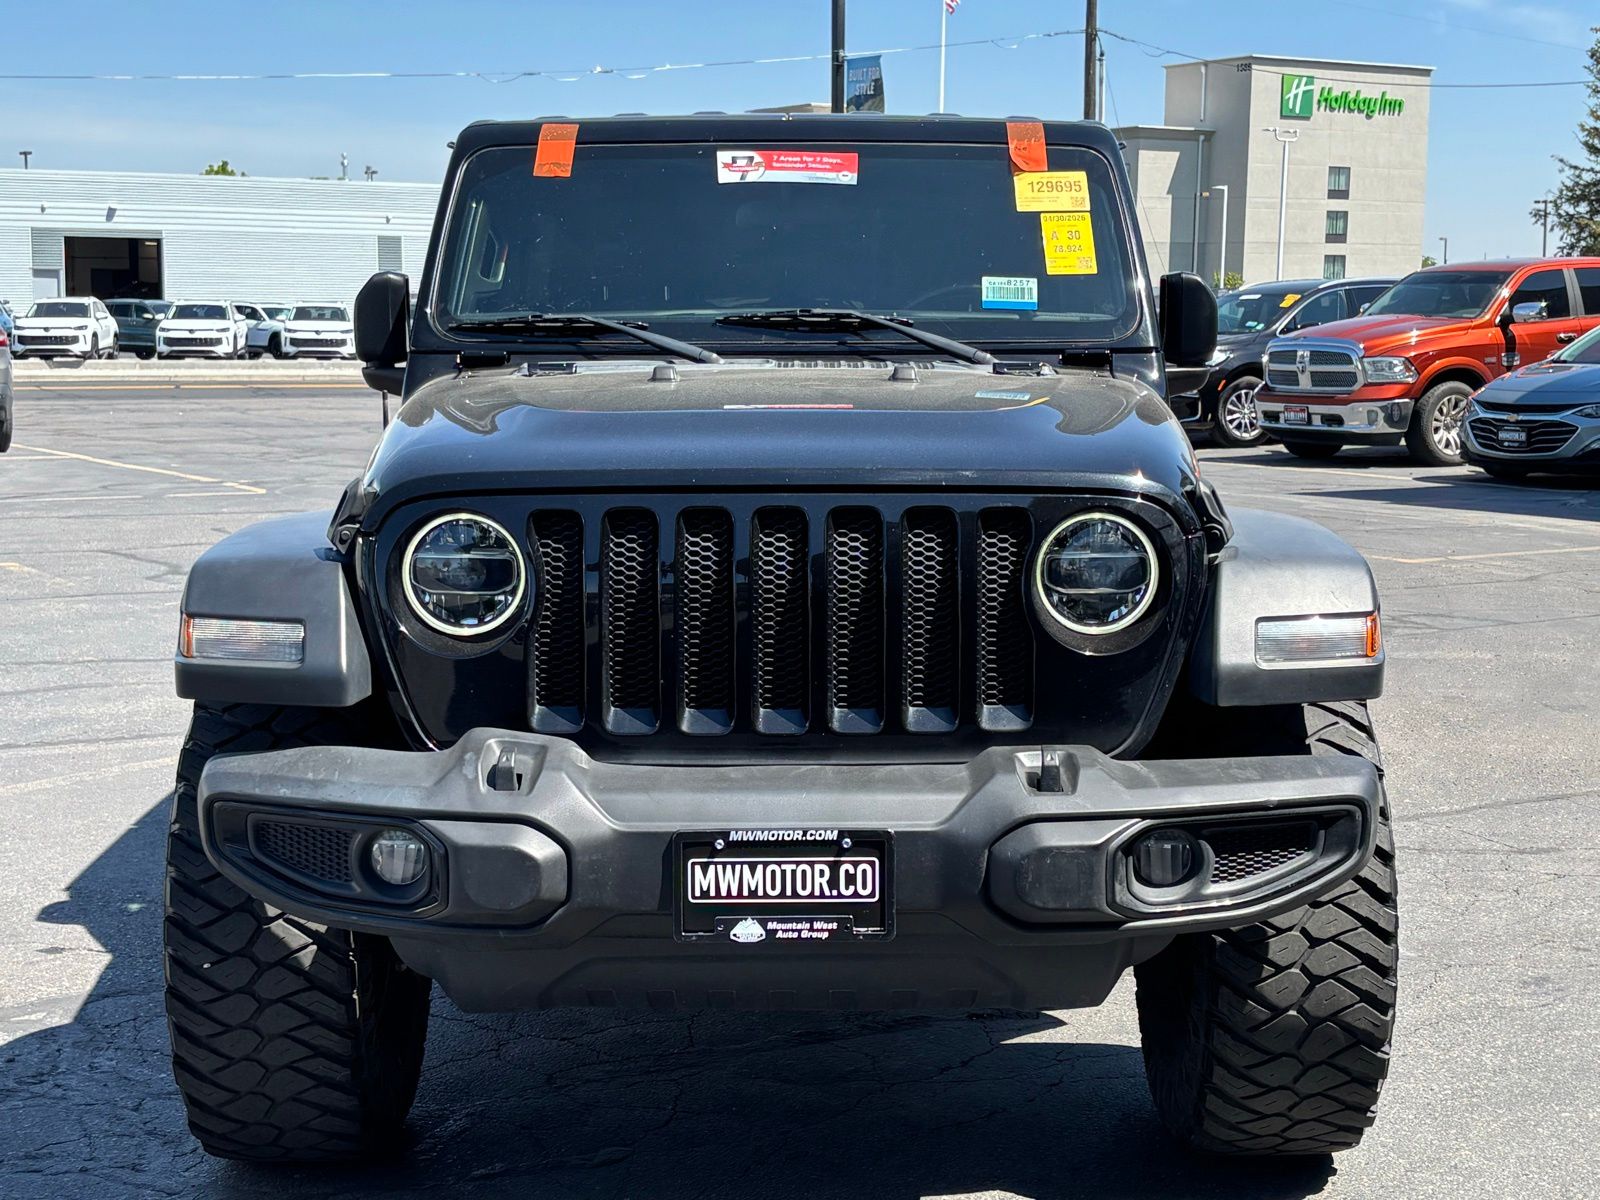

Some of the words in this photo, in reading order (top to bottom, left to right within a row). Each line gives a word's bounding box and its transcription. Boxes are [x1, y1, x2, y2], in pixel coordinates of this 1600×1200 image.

[855, 82, 875, 96] STYLE
[1317, 87, 1377, 119] Holiday
[1377, 90, 1405, 116] Inn
[1027, 180, 1082, 193] 129695
[1067, 230, 1081, 241] 30
[729, 830, 839, 842] MWMOTOR.COM
[693, 863, 873, 897] MWMOTOR.CO
[766, 921, 811, 930] Mountain
[813, 921, 838, 930] West
[776, 930, 799, 938] Auto
[800, 930, 830, 940] Group
